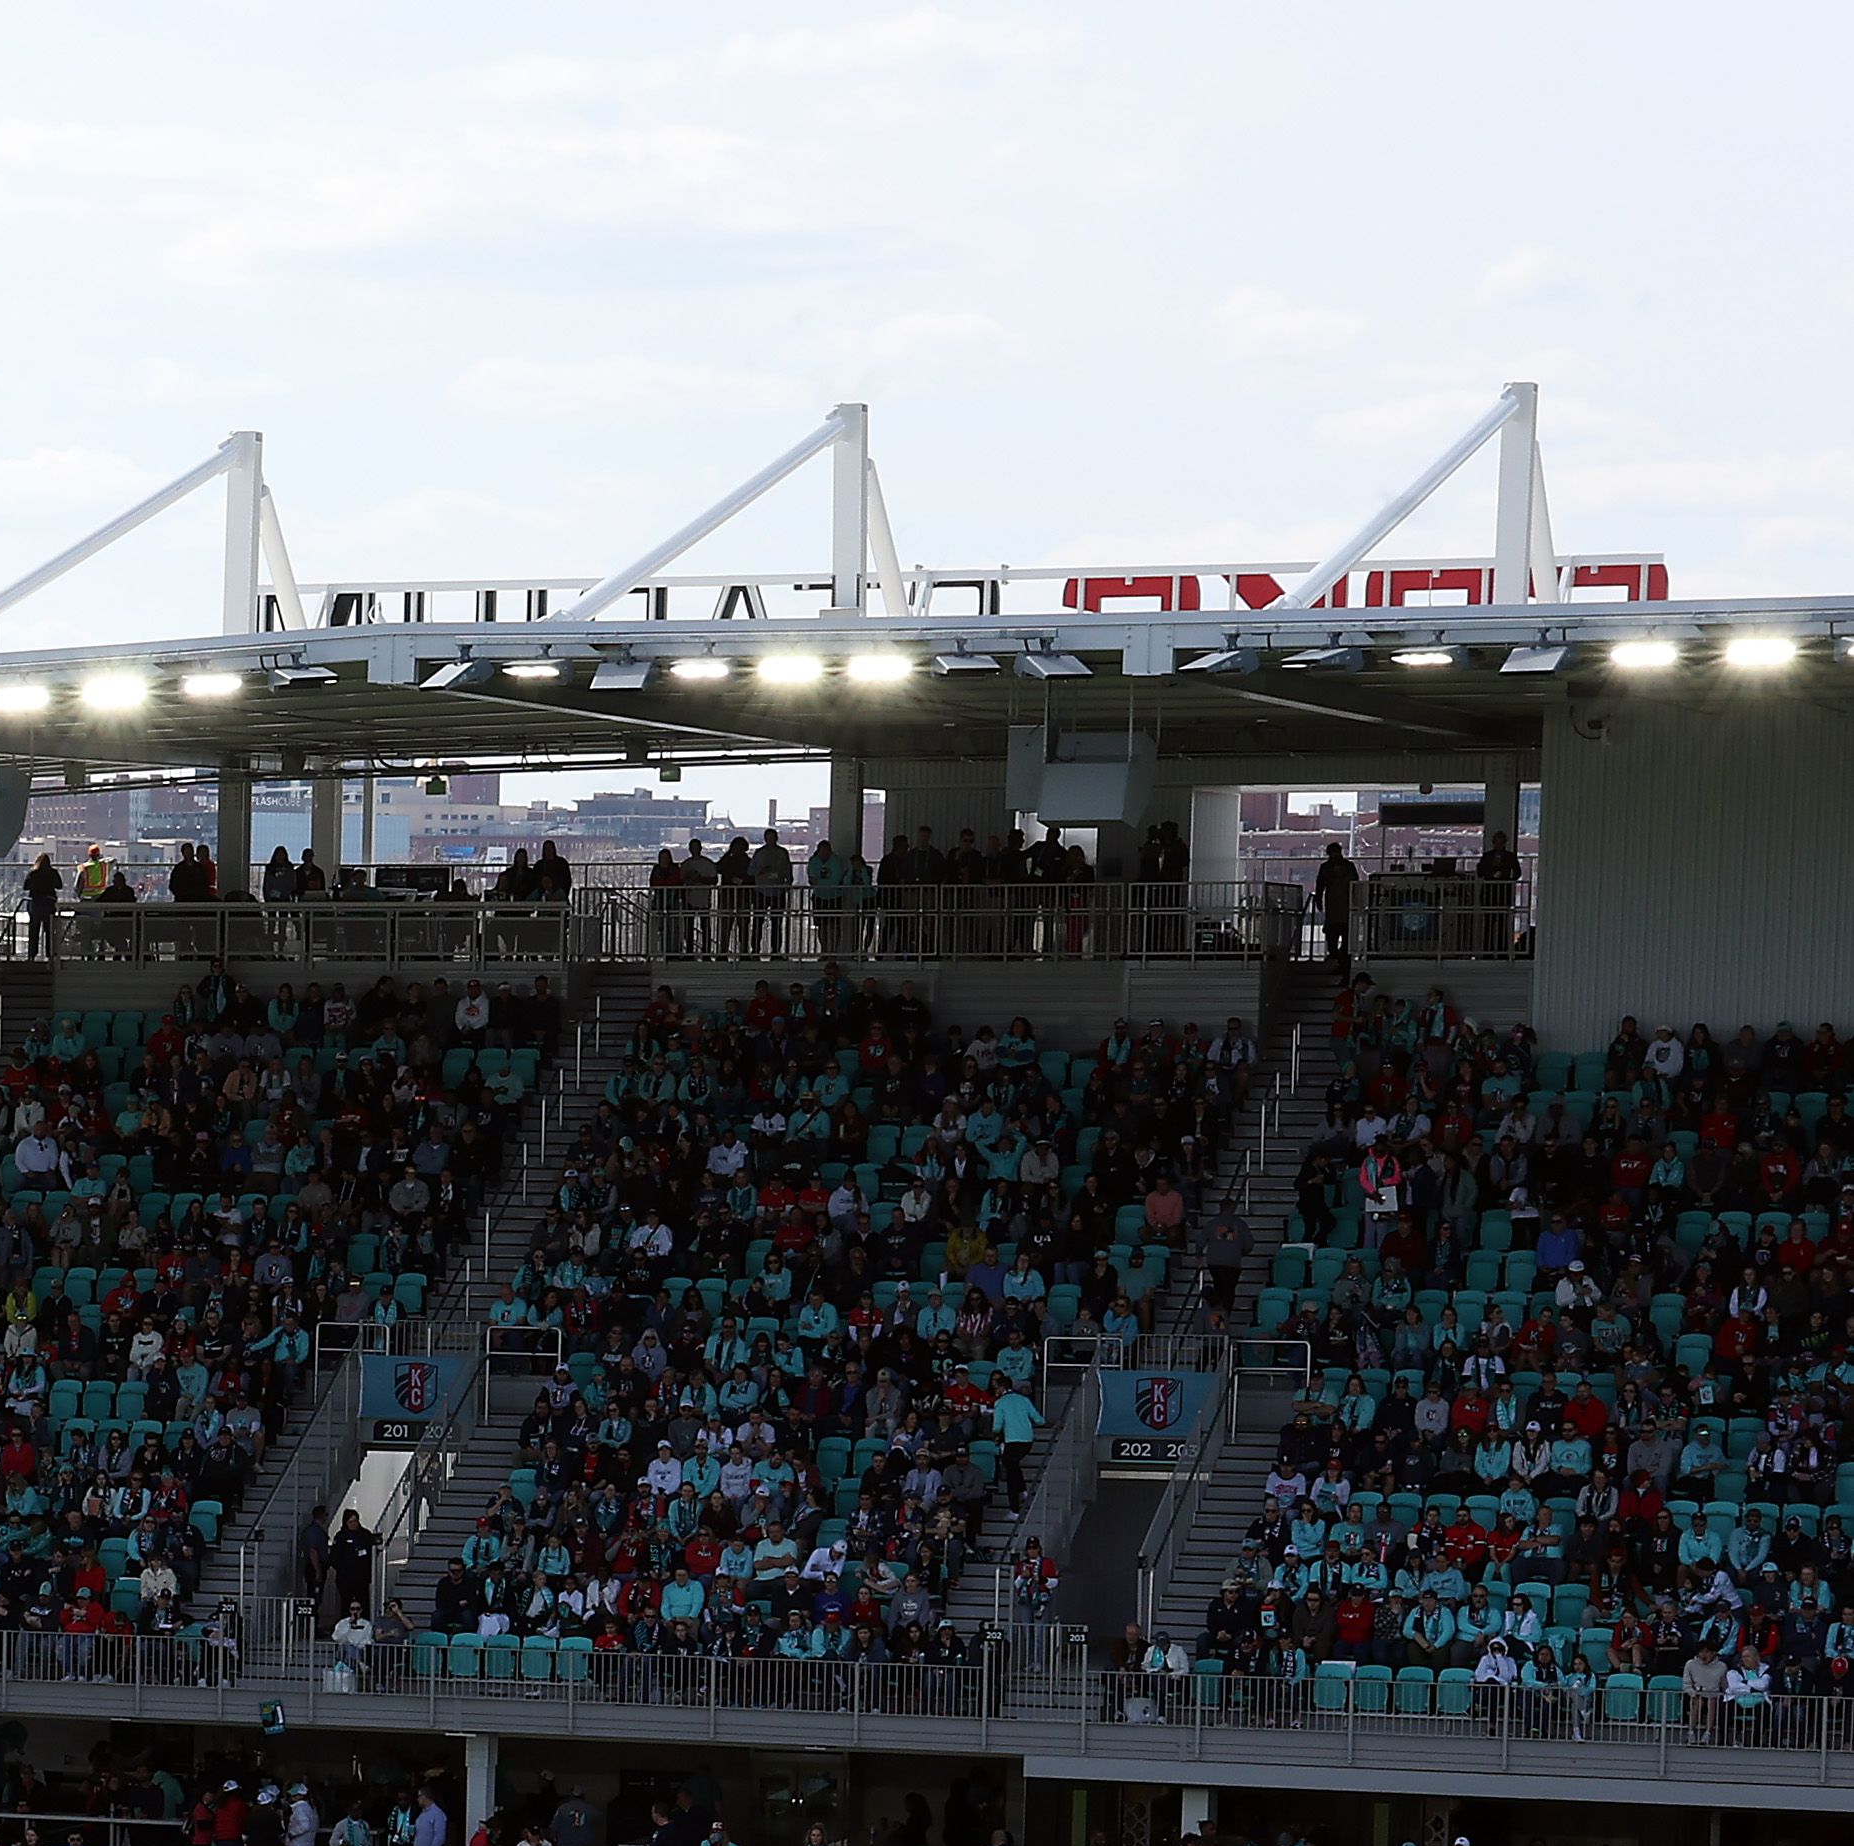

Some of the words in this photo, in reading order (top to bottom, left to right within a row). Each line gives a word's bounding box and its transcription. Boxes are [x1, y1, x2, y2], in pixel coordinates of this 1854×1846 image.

[383, 1424, 409, 1438] 201
[1120, 1444, 1152, 1457] 202
[221, 1604, 234, 1612] 201
[297, 1606, 312, 1614] 202
[986, 1631, 1002, 1640] 202
[1069, 1633, 1085, 1642] 203
